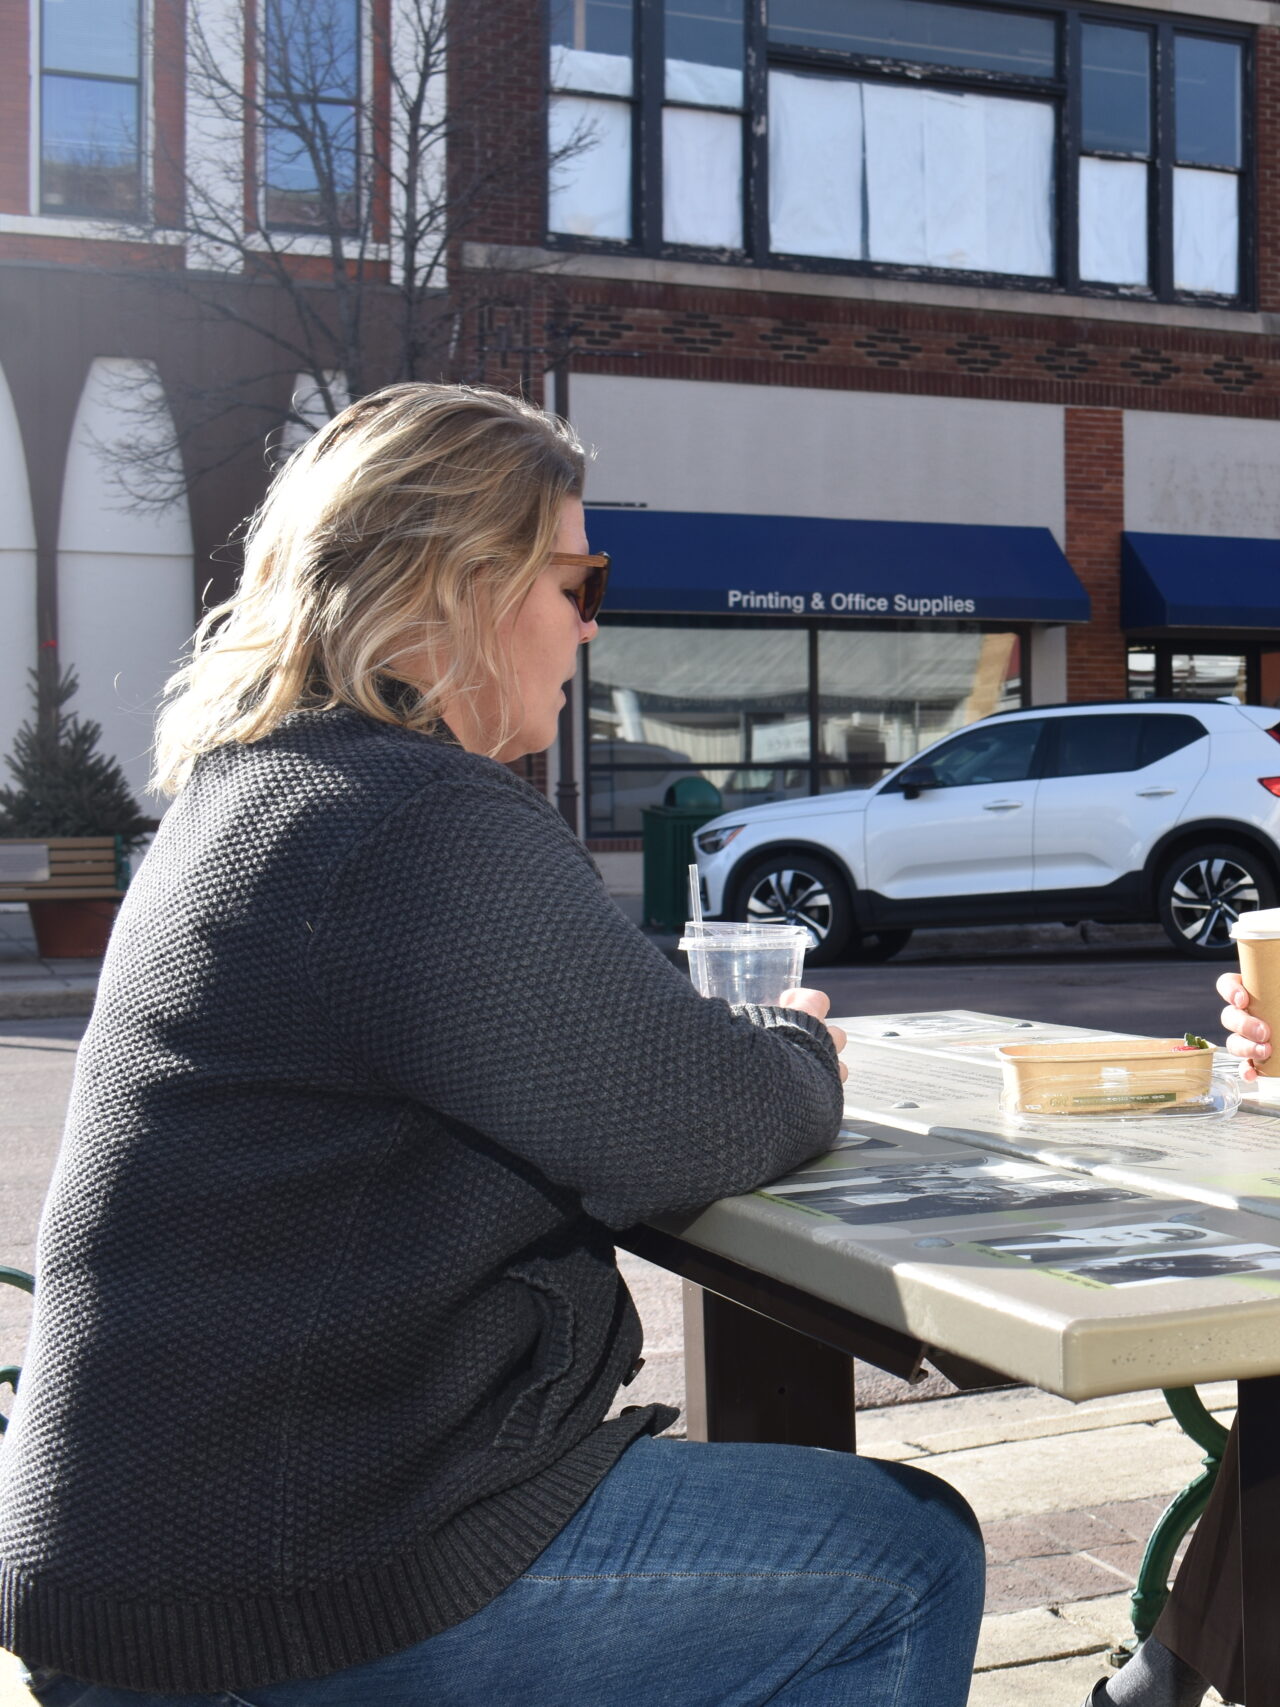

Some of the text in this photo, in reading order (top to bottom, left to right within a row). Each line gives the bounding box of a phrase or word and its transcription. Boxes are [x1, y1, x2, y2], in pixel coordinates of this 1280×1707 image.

[728, 590, 975, 616] Printing & Office Supplies
